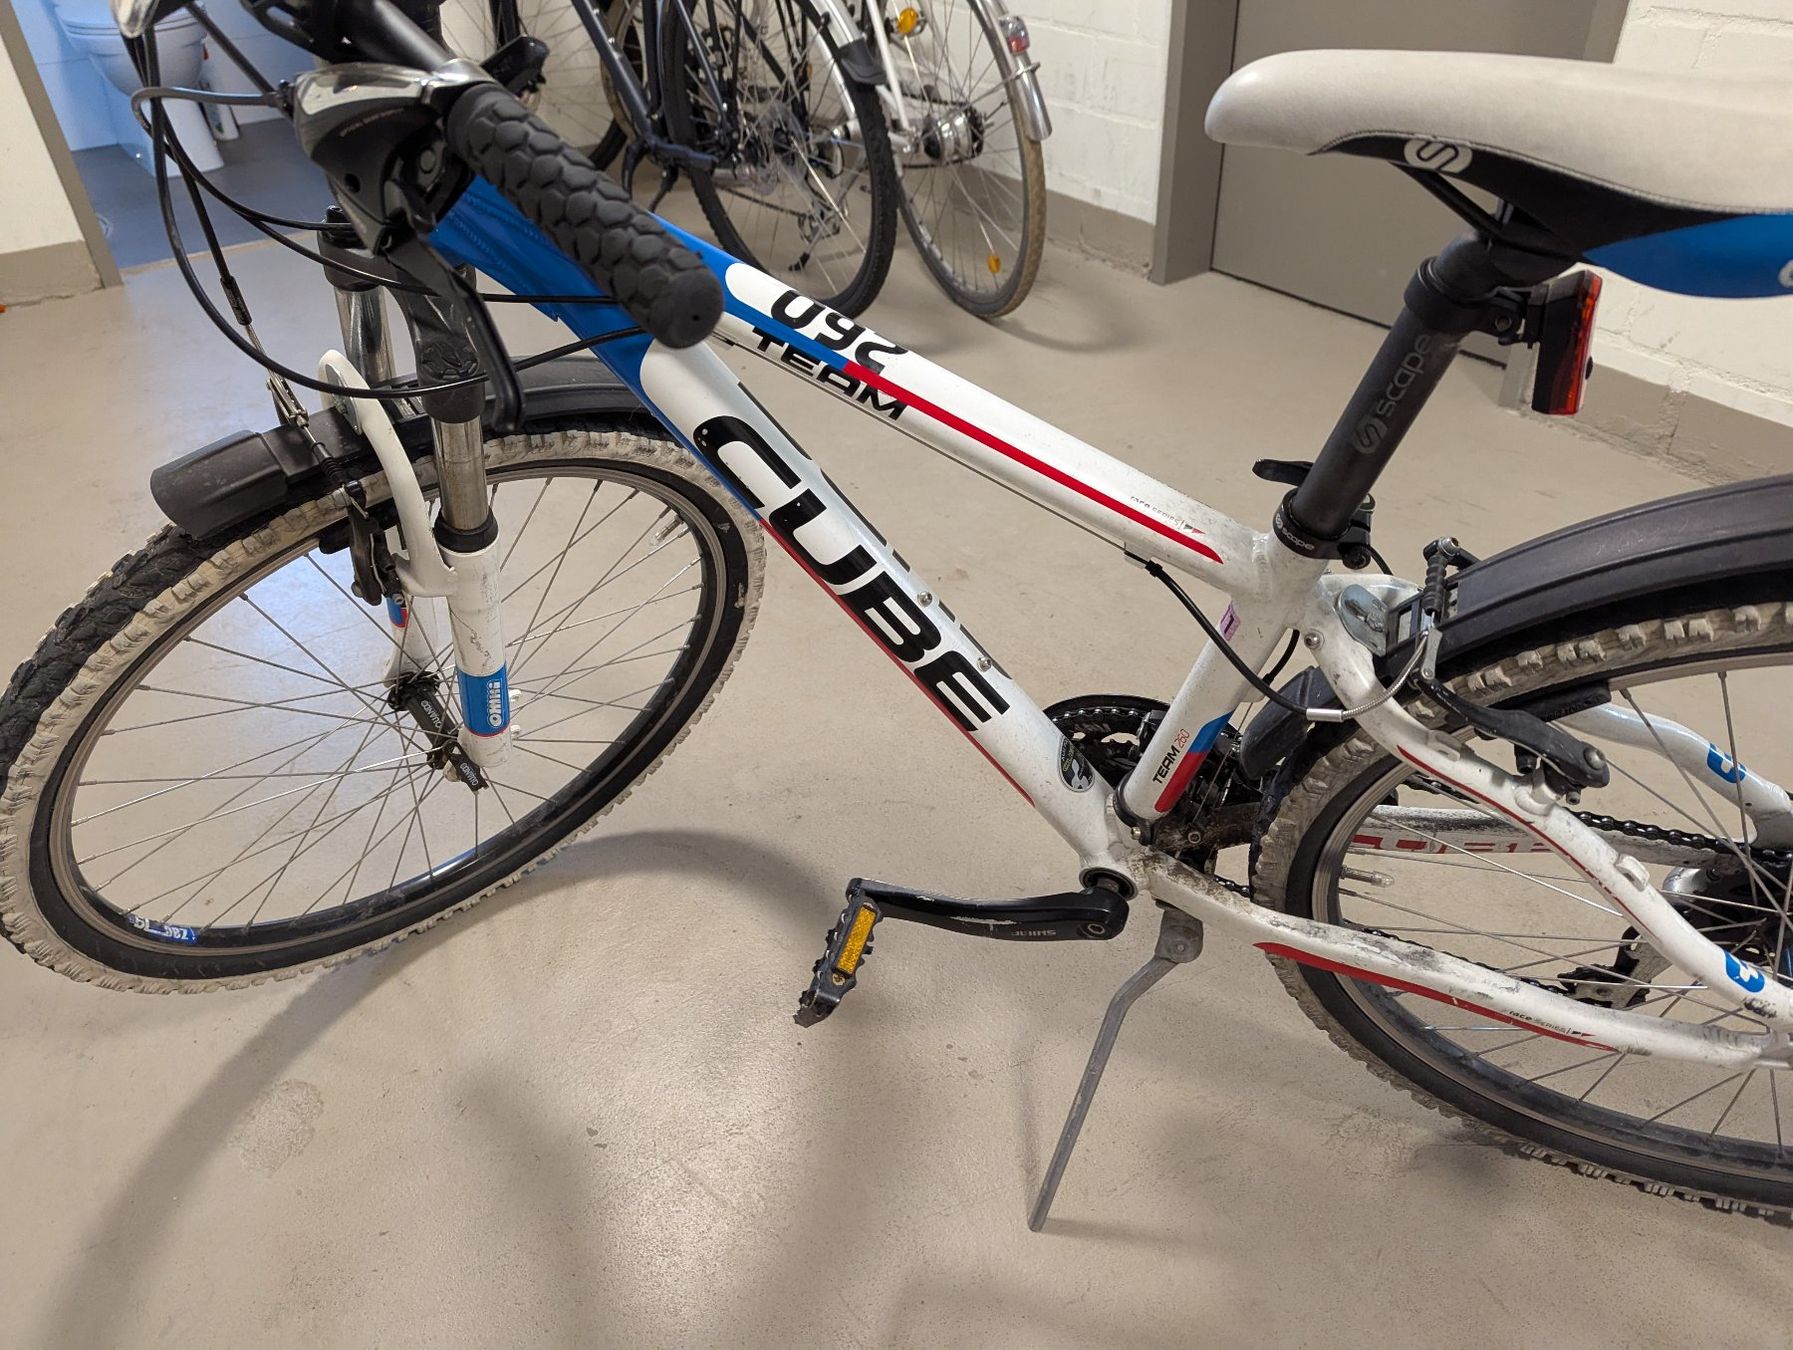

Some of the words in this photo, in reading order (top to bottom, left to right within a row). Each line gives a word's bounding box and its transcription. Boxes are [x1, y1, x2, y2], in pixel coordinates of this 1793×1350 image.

[752, 326, 907, 420] TEAM
[1377, 334, 1431, 417] scape
[693, 416, 1010, 731] CUBE
[1152, 745, 1180, 783] TEAM
[1175, 729, 1190, 748] 260
